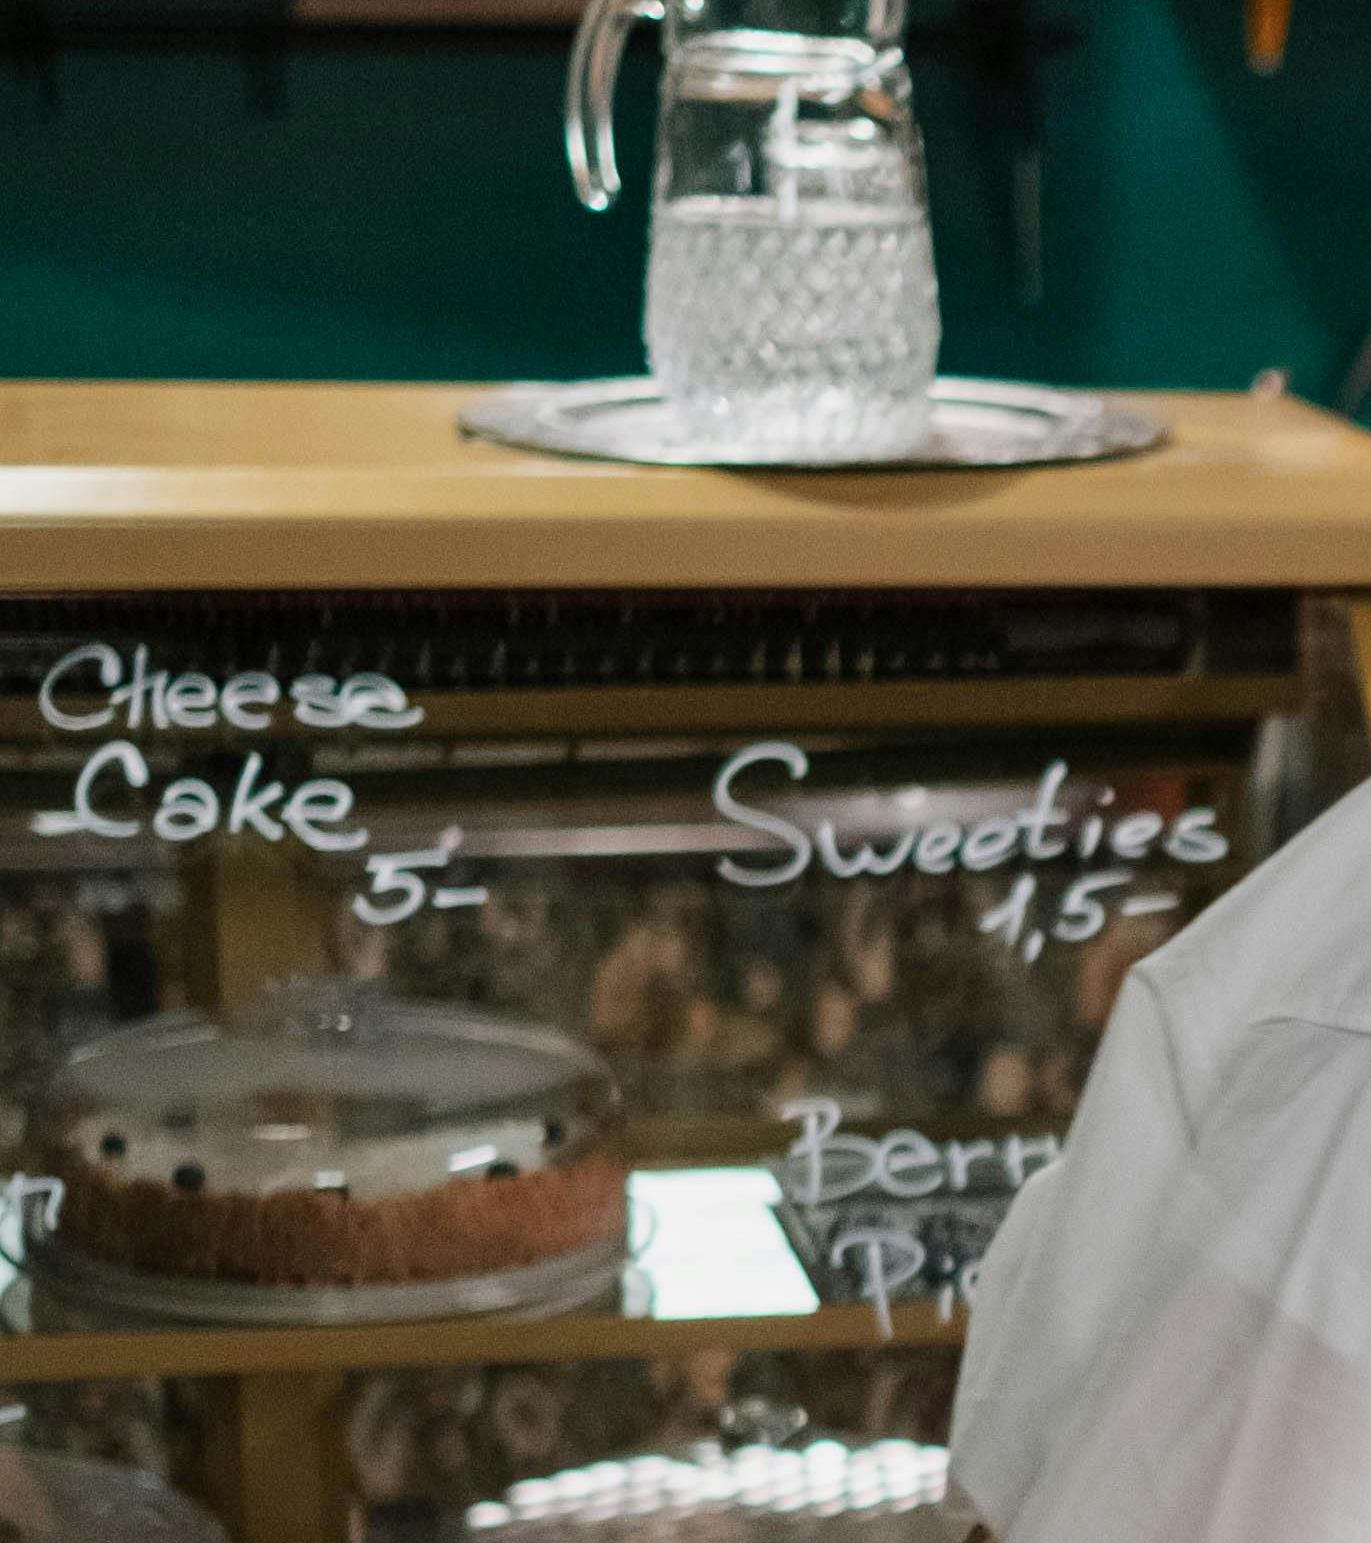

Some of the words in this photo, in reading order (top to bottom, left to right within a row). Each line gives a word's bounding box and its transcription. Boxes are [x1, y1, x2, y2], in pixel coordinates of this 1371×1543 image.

[38, 642, 426, 731] Cheese
[74, 740, 370, 852] Cake
[712, 741, 1228, 886] Sweeties
[781, 1098, 1060, 1205] Berr
